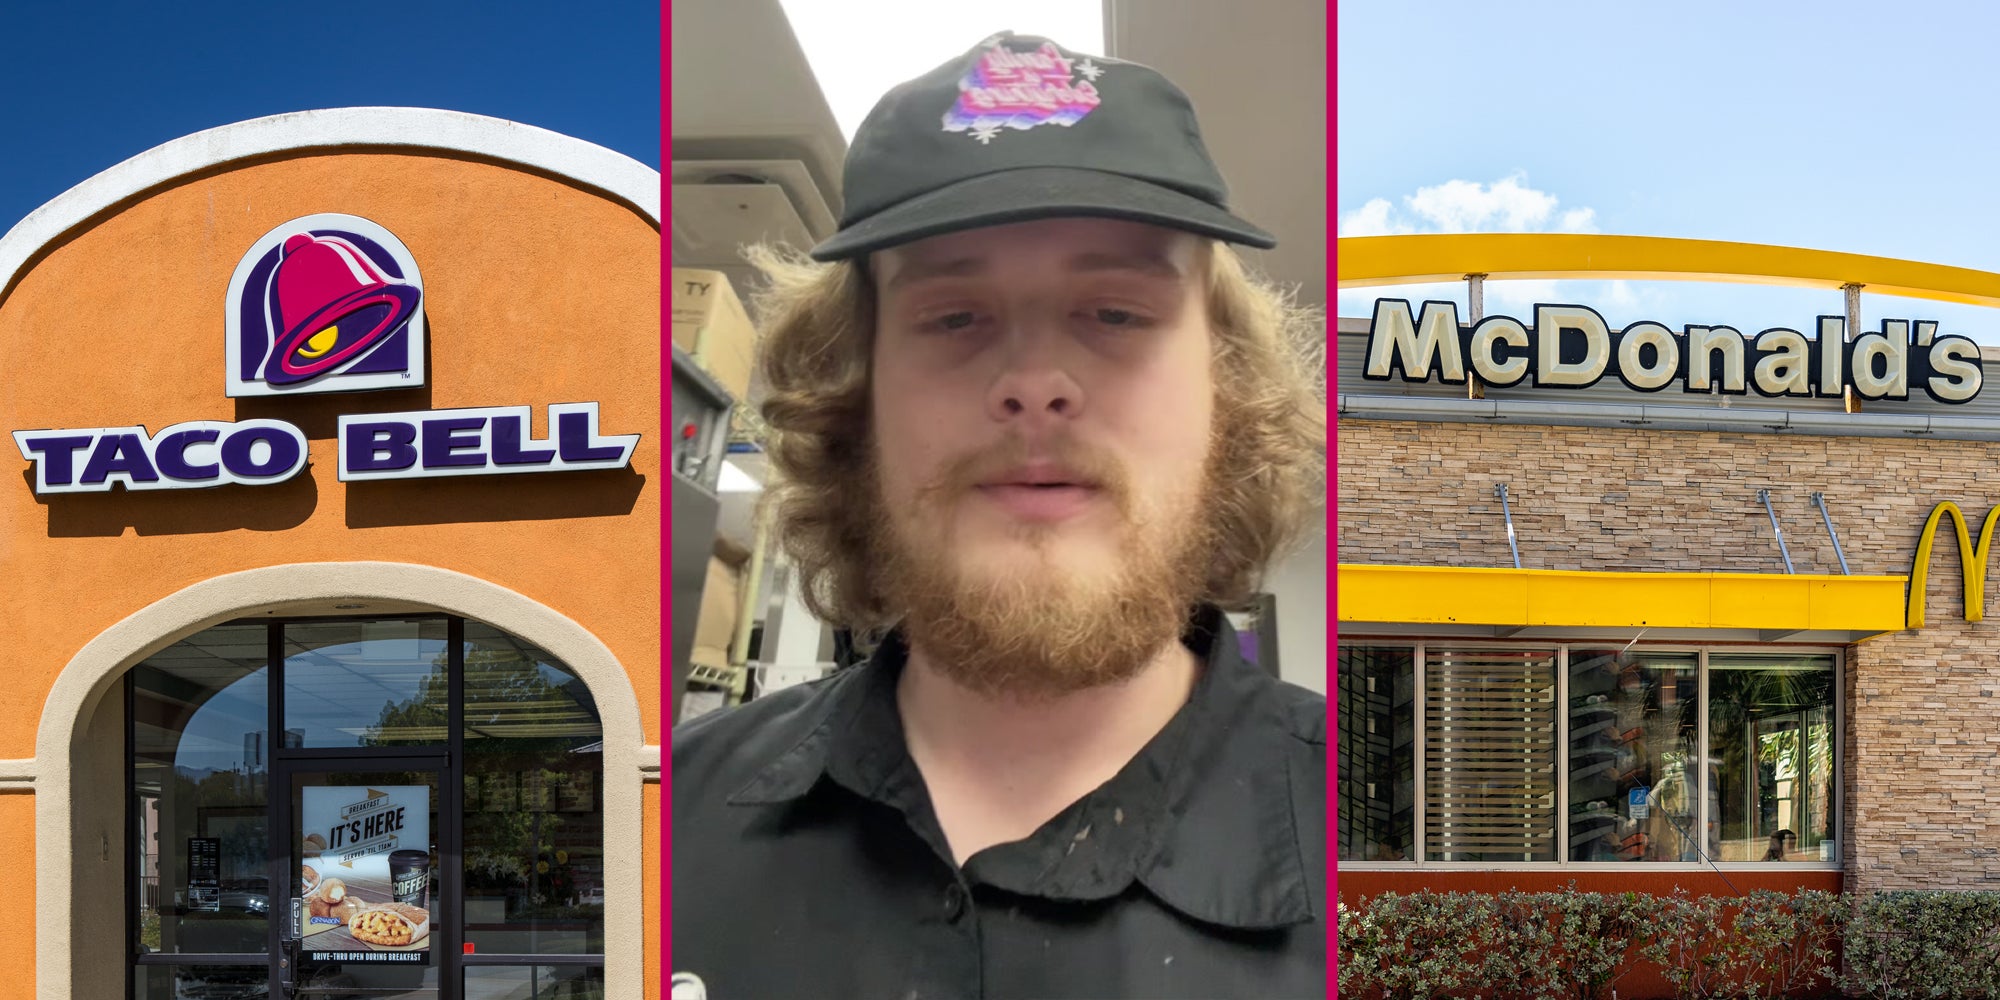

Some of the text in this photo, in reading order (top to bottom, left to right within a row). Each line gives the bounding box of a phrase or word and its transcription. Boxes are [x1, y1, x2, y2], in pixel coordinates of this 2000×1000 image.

[685, 281, 711, 295] TY
[1366, 299, 1982, 402] McDonald's
[26, 412, 625, 485] TACO BELL
[349, 799, 380, 814] BREAKFAST
[330, 807, 405, 849] IT'S HERE
[344, 850, 365, 861] SERVED
[378, 842, 392, 851] 11AM
[393, 873, 428, 895] COFFEE
[313, 953, 421, 961] DRIVE-THRU OPEN DURING BREAKFAST
